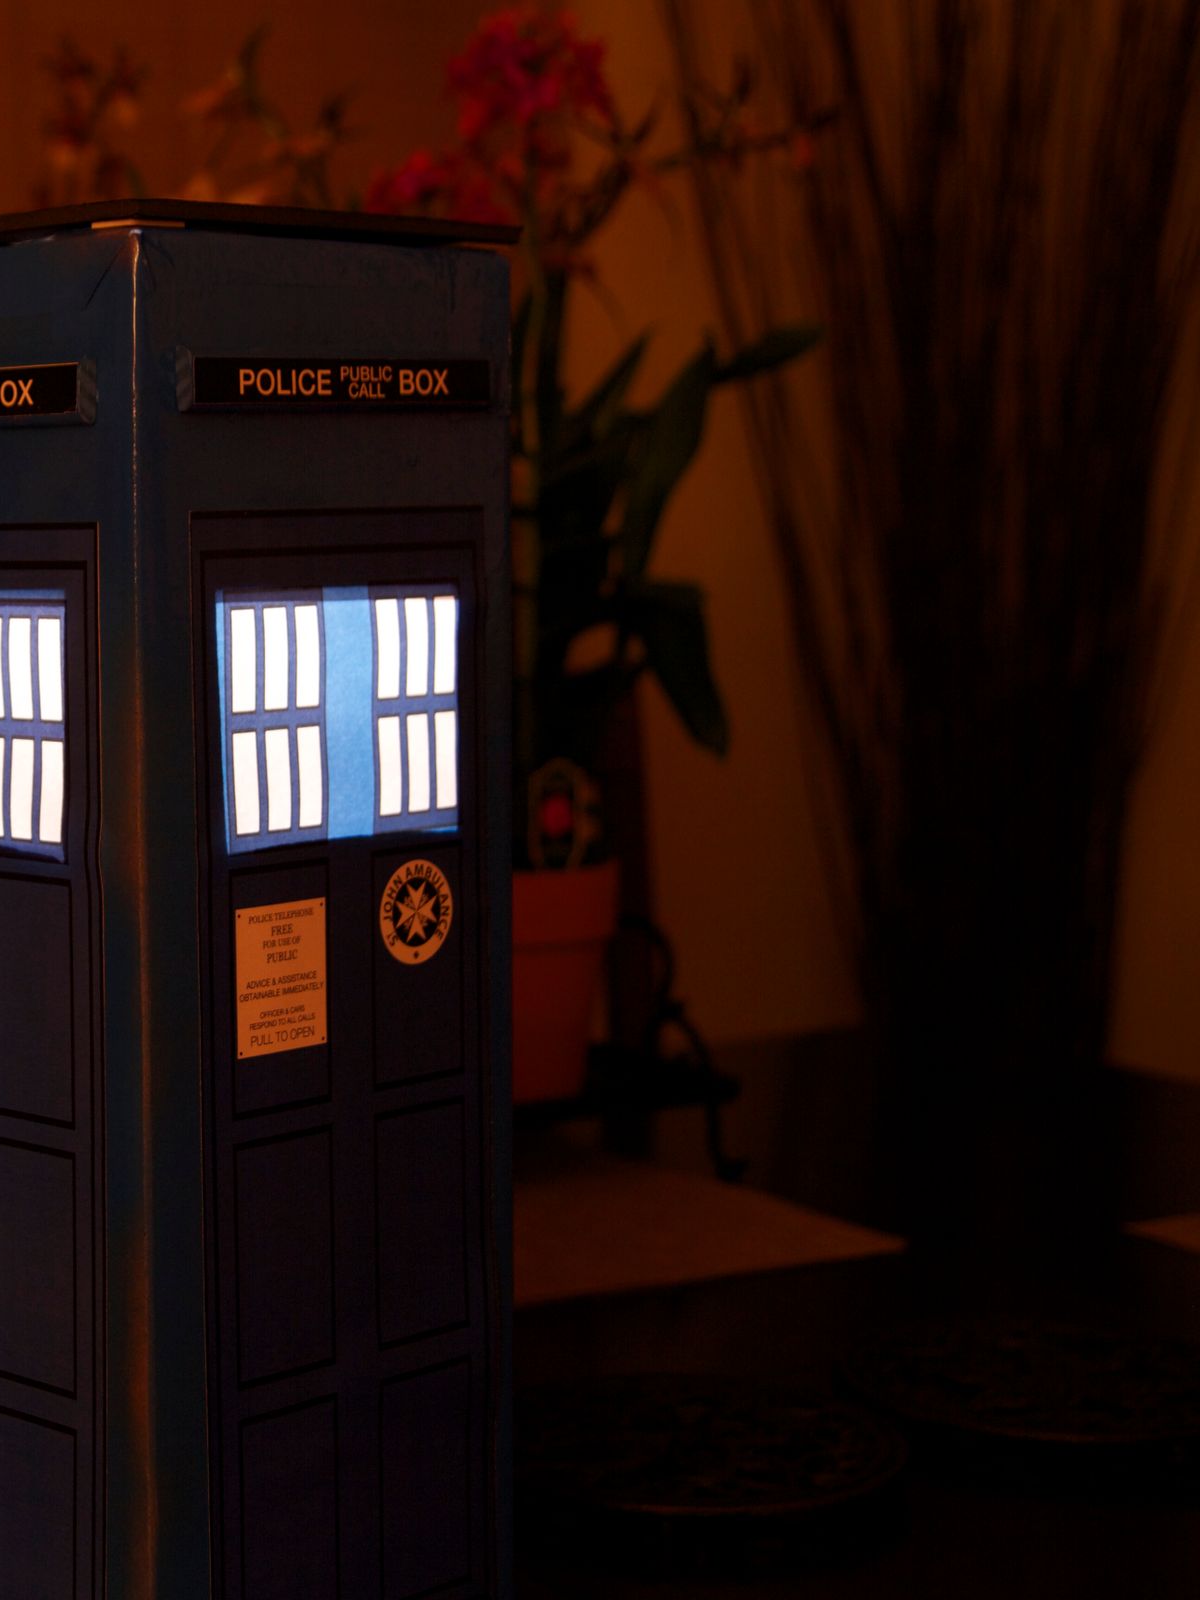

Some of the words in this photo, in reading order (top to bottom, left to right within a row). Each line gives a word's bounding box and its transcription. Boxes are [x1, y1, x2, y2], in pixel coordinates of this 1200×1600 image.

[237, 367, 332, 395] POLICE
[340, 365, 393, 382] PUBLIC
[399, 368, 449, 395] BOX
[349, 381, 386, 398] CALL
[248, 914, 274, 925] POLICE
[274, 907, 313, 921] TELEPHONE
[271, 923, 294, 937] FREE
[263, 939, 277, 949] FOR
[278, 936, 291, 947] USE
[292, 935, 301, 945] OF
[266, 949, 299, 964] PUBLIC
[246, 978, 271, 990] ADVICE
[278, 970, 317, 984] ASSISTANCE
[239, 988, 281, 1003] OBTAINABLE
[282, 981, 324, 995] IMMEDIATELY
[249, 1019, 278, 1031] RESPOND
[287, 1016, 297, 1024] ALL
[297, 1012, 316, 1022] CALLS
[250, 1033, 273, 1047] PULL
[275, 1030, 289, 1042] TO
[290, 1025, 315, 1040] OPEN
